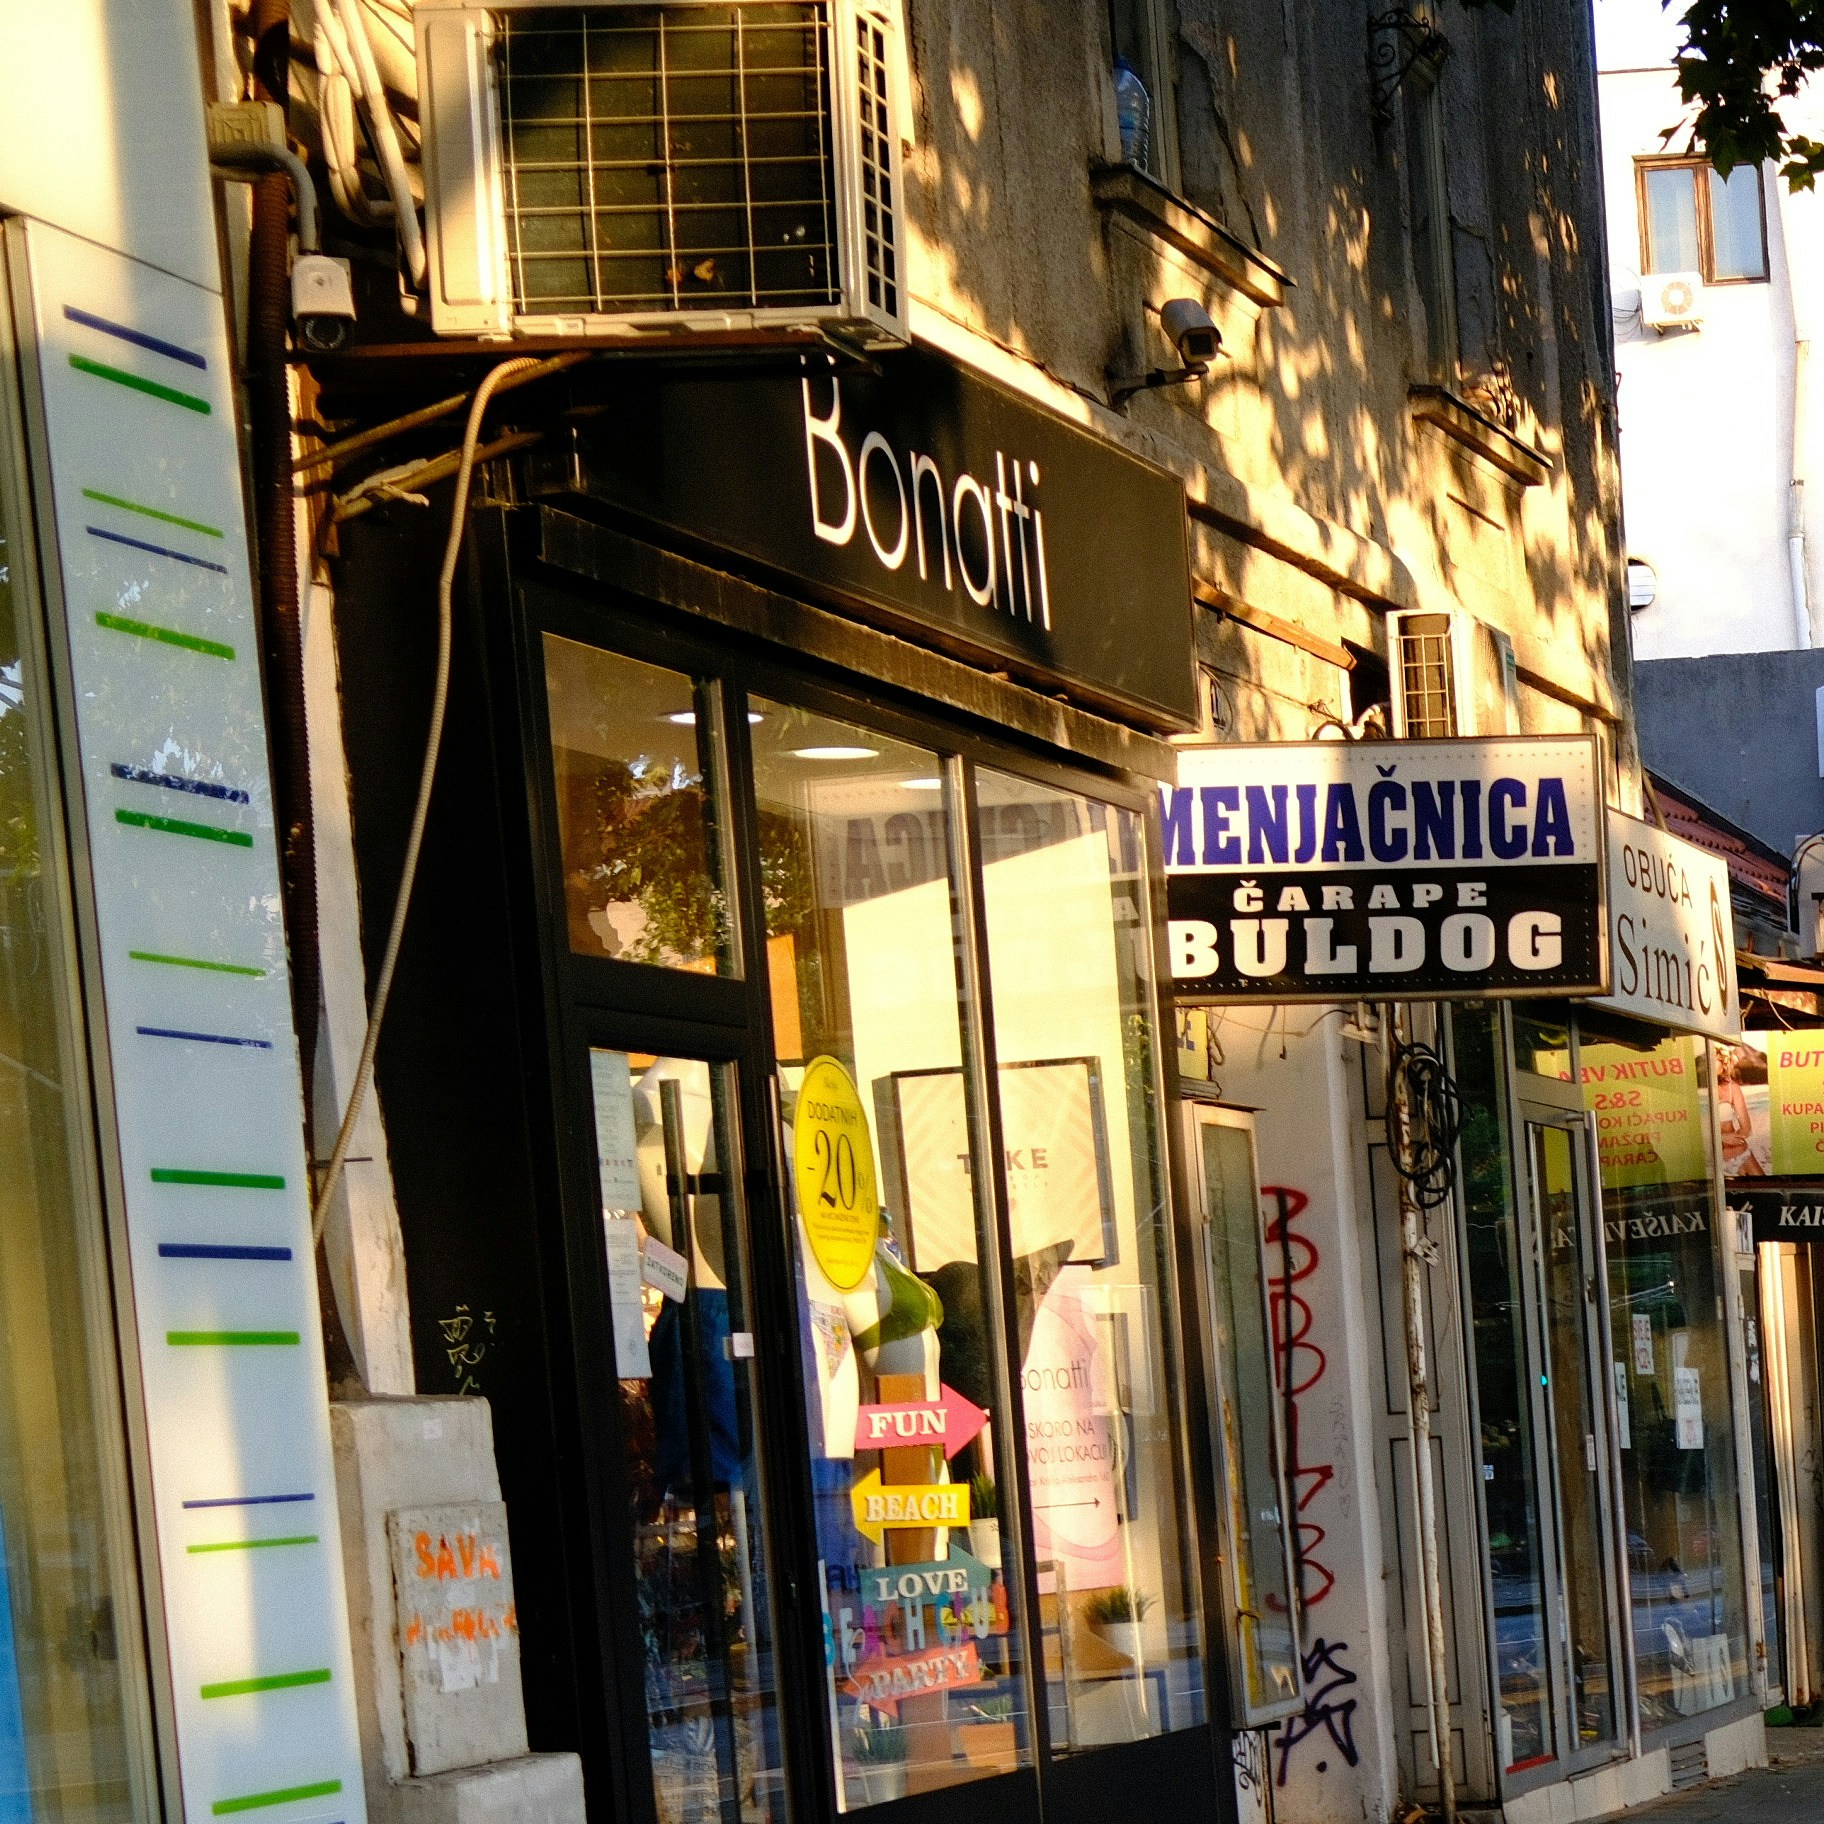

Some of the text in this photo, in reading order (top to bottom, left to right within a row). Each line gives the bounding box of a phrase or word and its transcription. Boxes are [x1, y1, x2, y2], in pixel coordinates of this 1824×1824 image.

[801, 354, 1051, 631] Bonatti
[1158, 764, 1575, 867] MENJAČNICA
[1233, 879, 1487, 912] ČARAPE
[1623, 844, 1693, 909] OBUĆA
[1168, 910, 1562, 978] BULDOG
[1617, 913, 1712, 1016] Simić
[808, 1101, 858, 1127] DODATNIH
[957, 1148, 1049, 1174] TKE
[868, 1408, 948, 1439] FUN
[1028, 1420, 1096, 1440] SKORO NA
[864, 1492, 958, 1523] BEACH
[415, 1530, 500, 1581] SAVA
[876, 1568, 969, 1602] LOVE
[870, 1650, 970, 1700] PARTY
